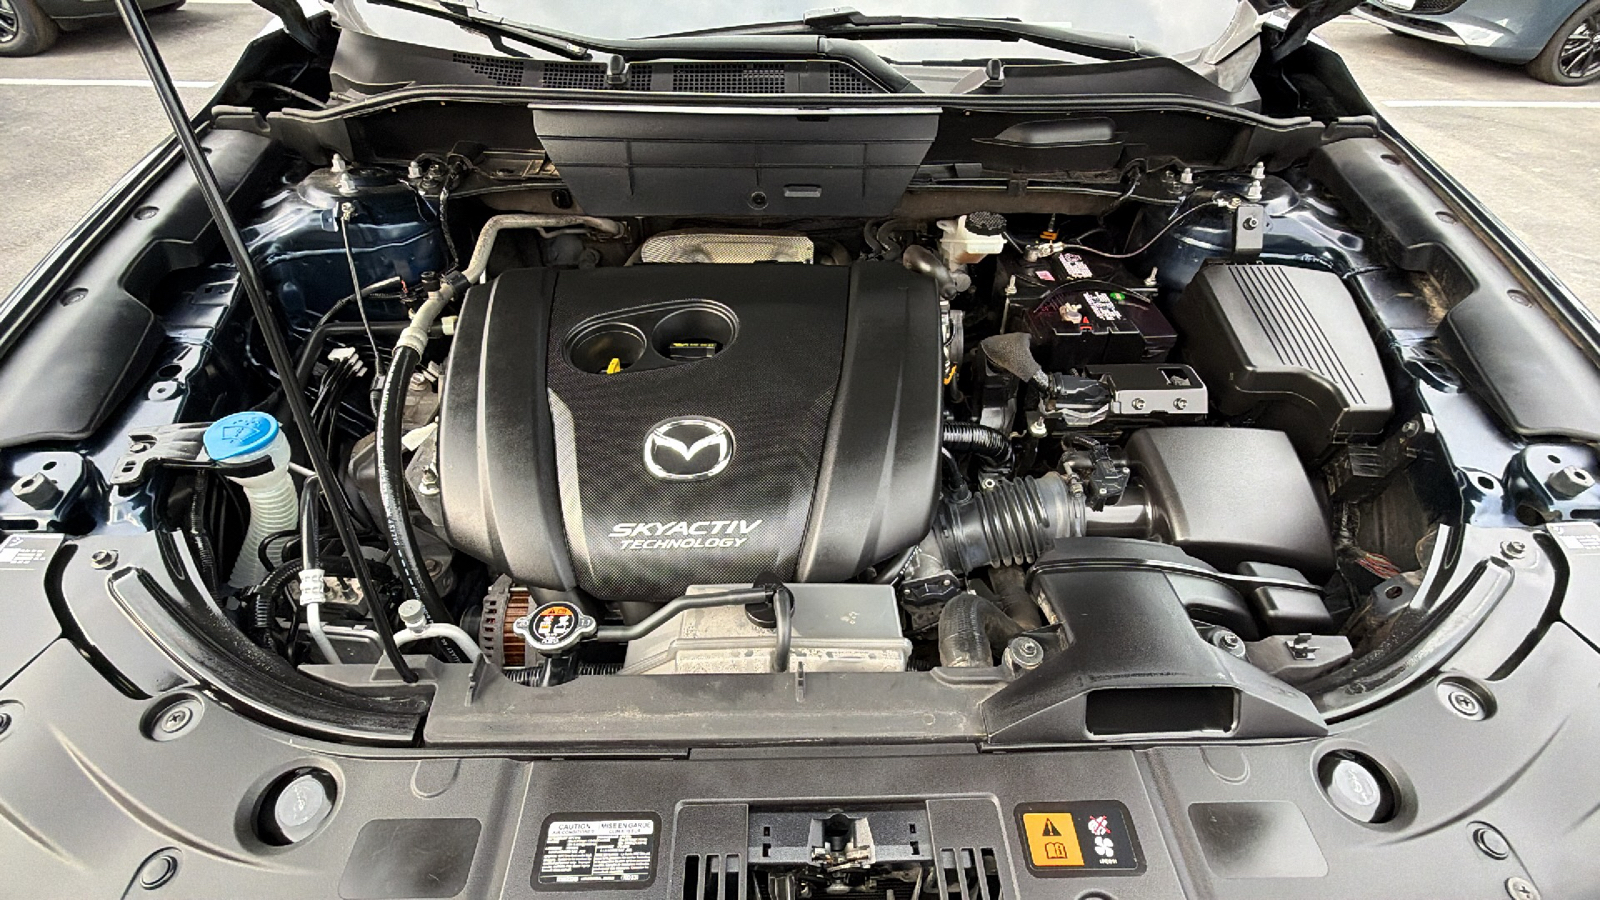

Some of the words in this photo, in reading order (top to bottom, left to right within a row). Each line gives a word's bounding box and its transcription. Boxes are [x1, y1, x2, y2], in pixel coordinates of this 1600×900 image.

[608, 519, 763, 537] SKYACTIV
[620, 538, 748, 550] TECHNOLOGY
[558, 823, 591, 831] CAUTION
